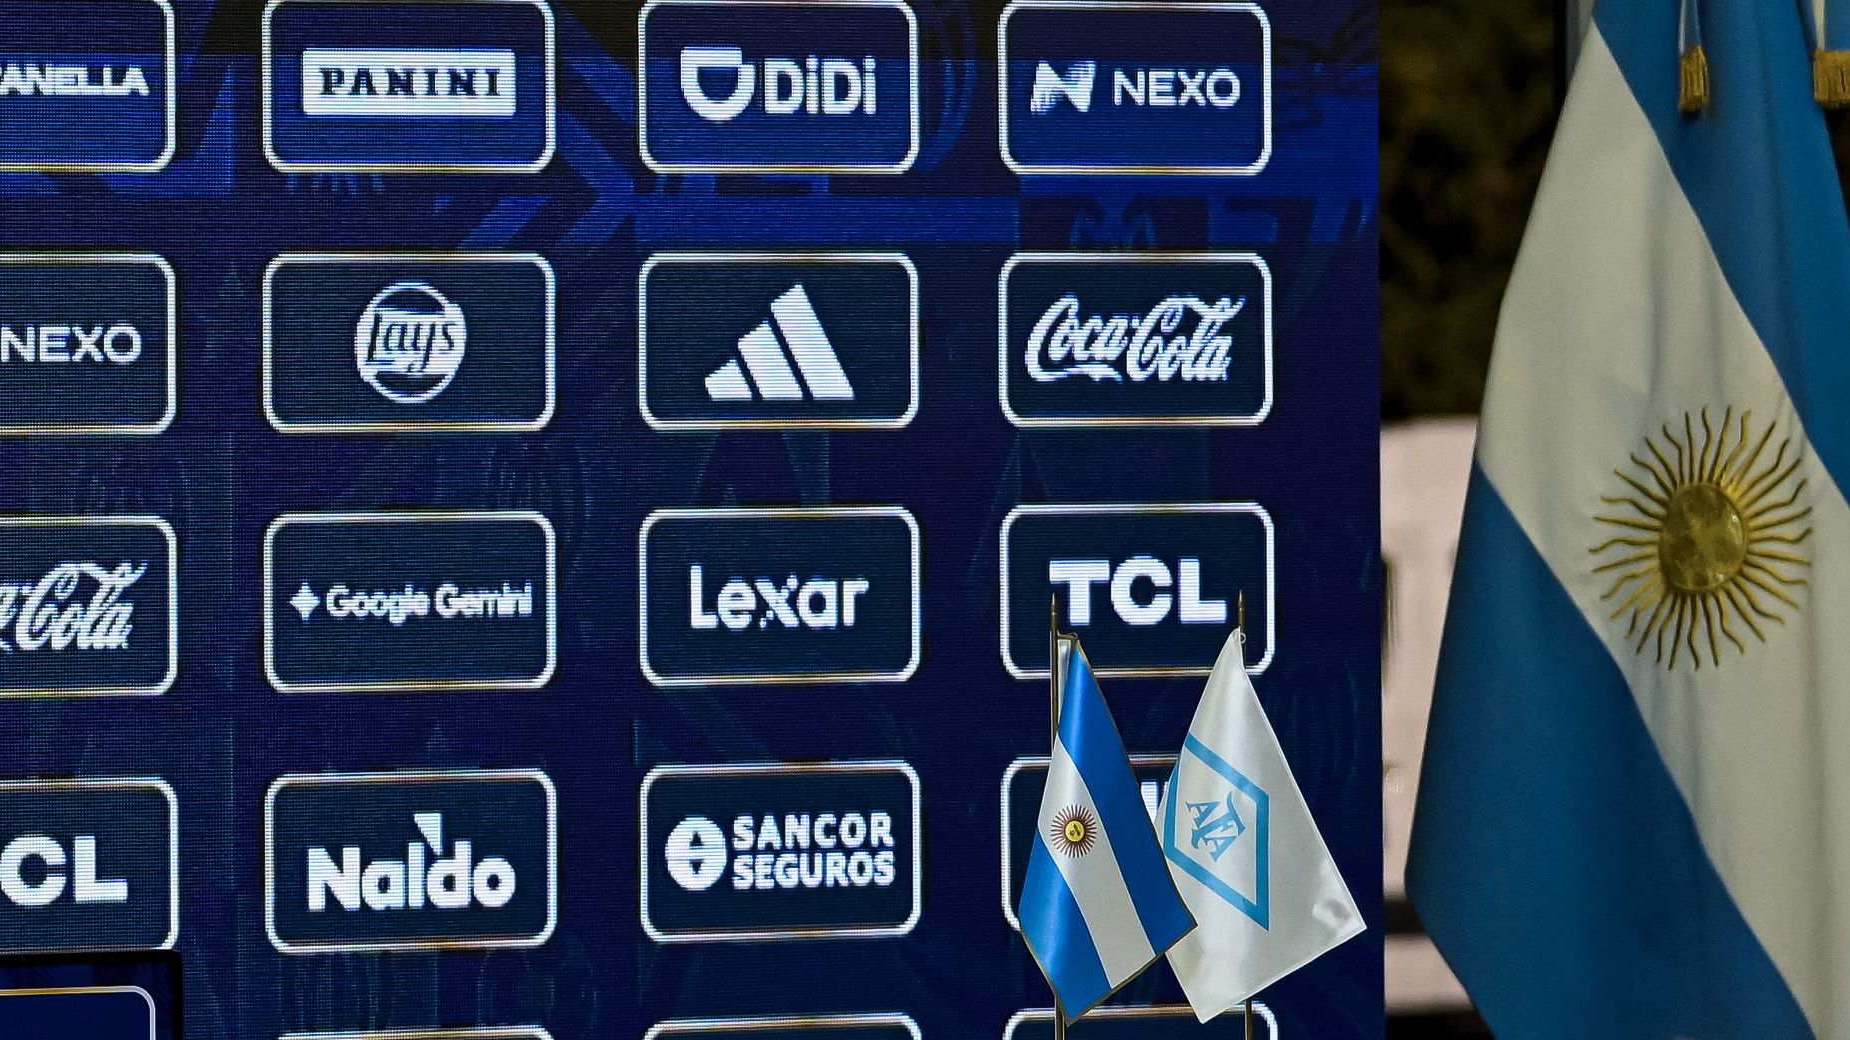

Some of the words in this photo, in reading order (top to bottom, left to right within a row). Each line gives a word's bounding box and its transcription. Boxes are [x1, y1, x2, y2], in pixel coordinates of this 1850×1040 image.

[321, 68, 498, 97] PANINI
[765, 57, 876, 114] DiDi
[1114, 69, 1240, 107] NEXO
[0, 324, 141, 364] NEXO
[326, 585, 429, 625] Google
[435, 583, 532, 618] Gemini
[690, 565, 869, 629] Lexar
[1049, 557, 1226, 625] TCL
[733, 812, 894, 847] SANCOR
[308, 813, 515, 911] Naldo
[734, 851, 894, 889] SEGUROS
